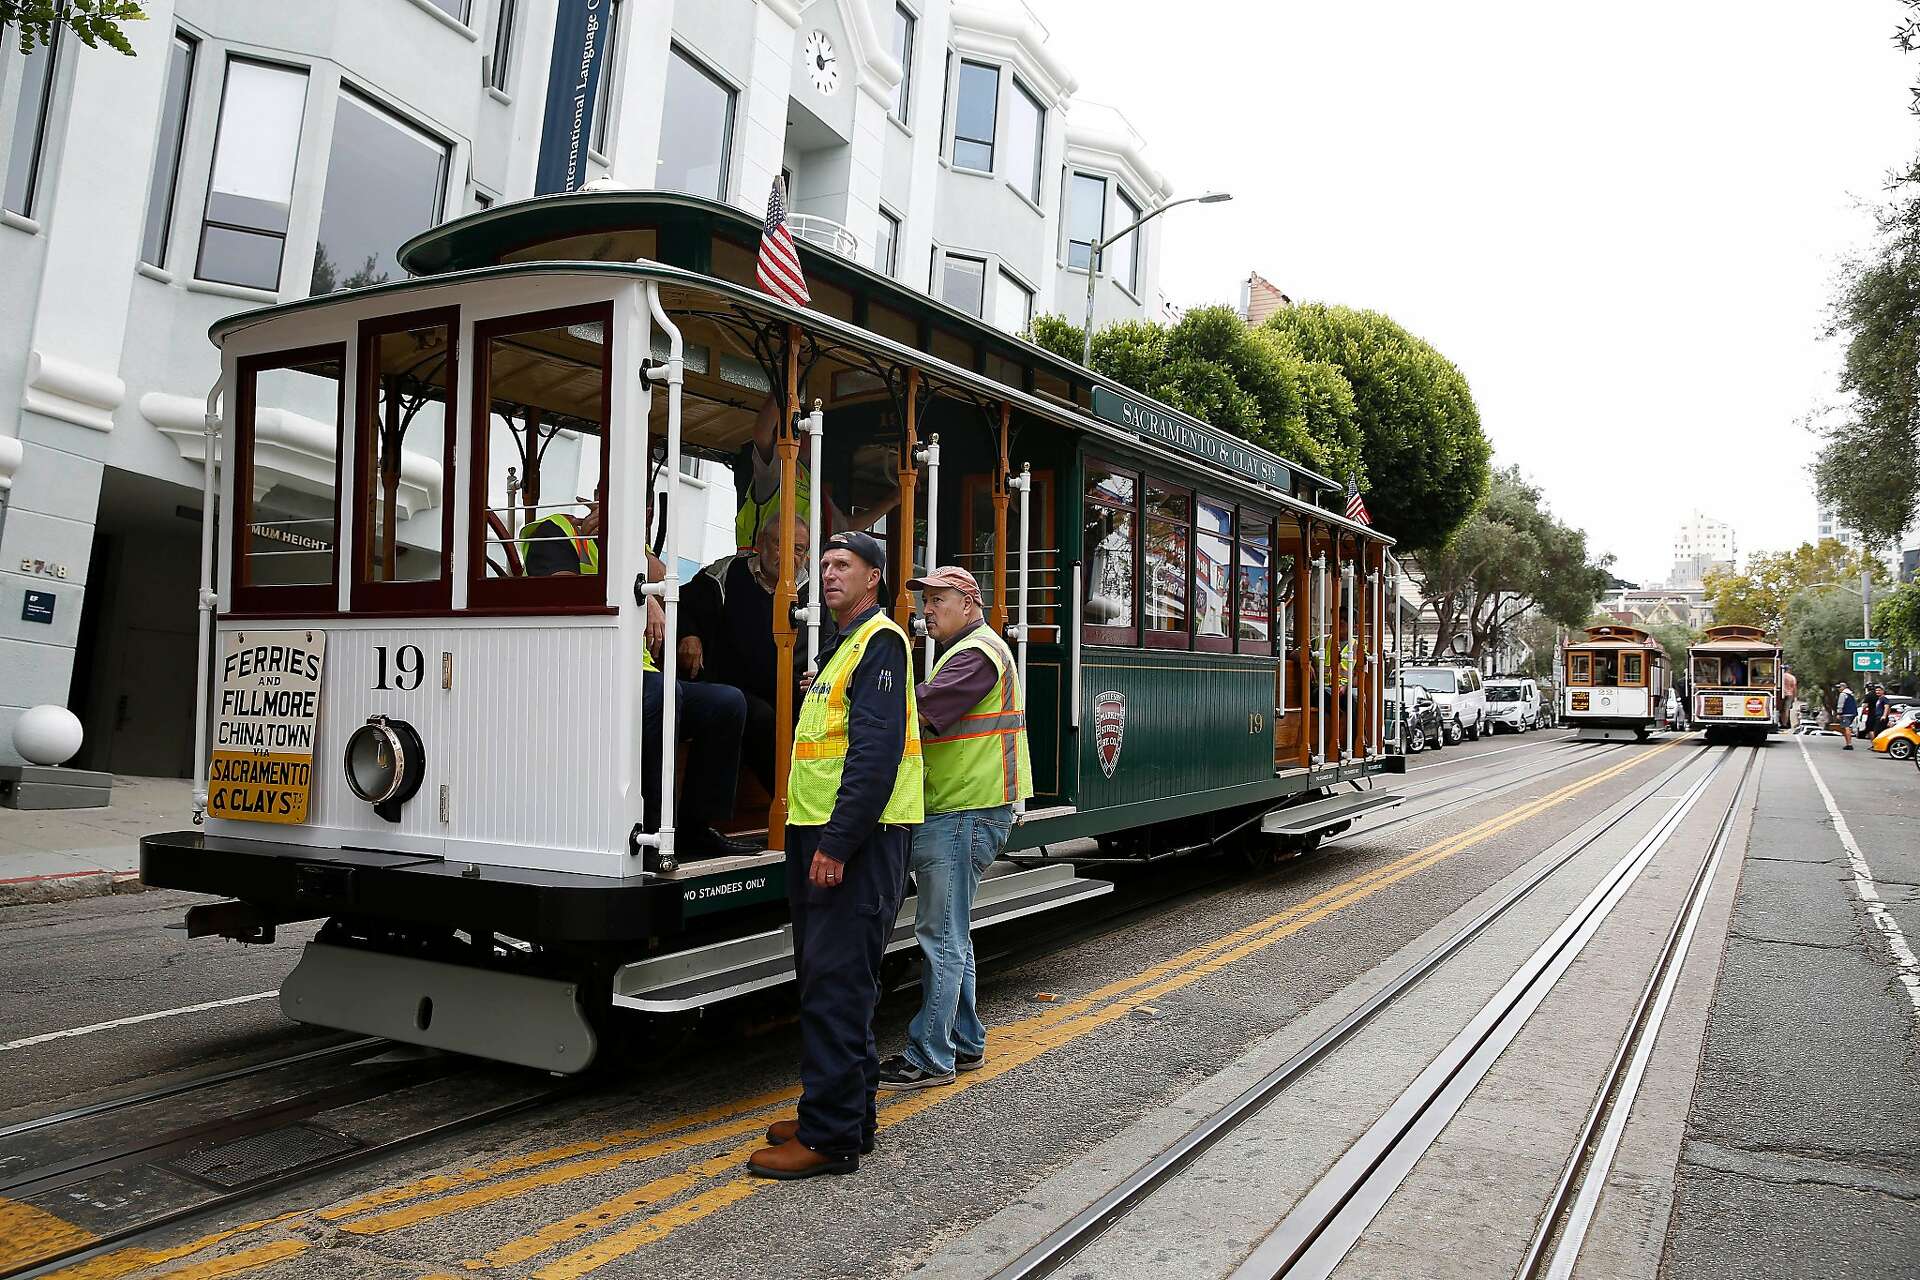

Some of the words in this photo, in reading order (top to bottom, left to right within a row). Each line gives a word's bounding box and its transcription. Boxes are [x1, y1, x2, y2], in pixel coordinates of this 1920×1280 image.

[565, 94, 585, 192] nternational
[576, 14, 599, 91] Language
[1122, 402, 1216, 457] SACRAMENTO
[1219, 442, 1229, 463] &
[1232, 449, 1259, 476] CLAY
[251, 525, 280, 539] MUM
[282, 531, 327, 551] HEIGHT
[223, 646, 320, 682] FERRIES
[370, 645, 425, 690] 19
[258, 677, 281, 686] AND
[221, 690, 316, 717] FILLMORE
[219, 722, 312, 747] CHINATOWN
[1249, 713, 1262, 734] 19
[253, 748, 270, 757] VIA
[212, 759, 310, 786] SACRAMENTO
[213, 788, 227, 809] &
[230, 789, 277, 813] CLAY
[699, 882, 743, 899] STANDEES
[746, 878, 766, 890] ONLY
